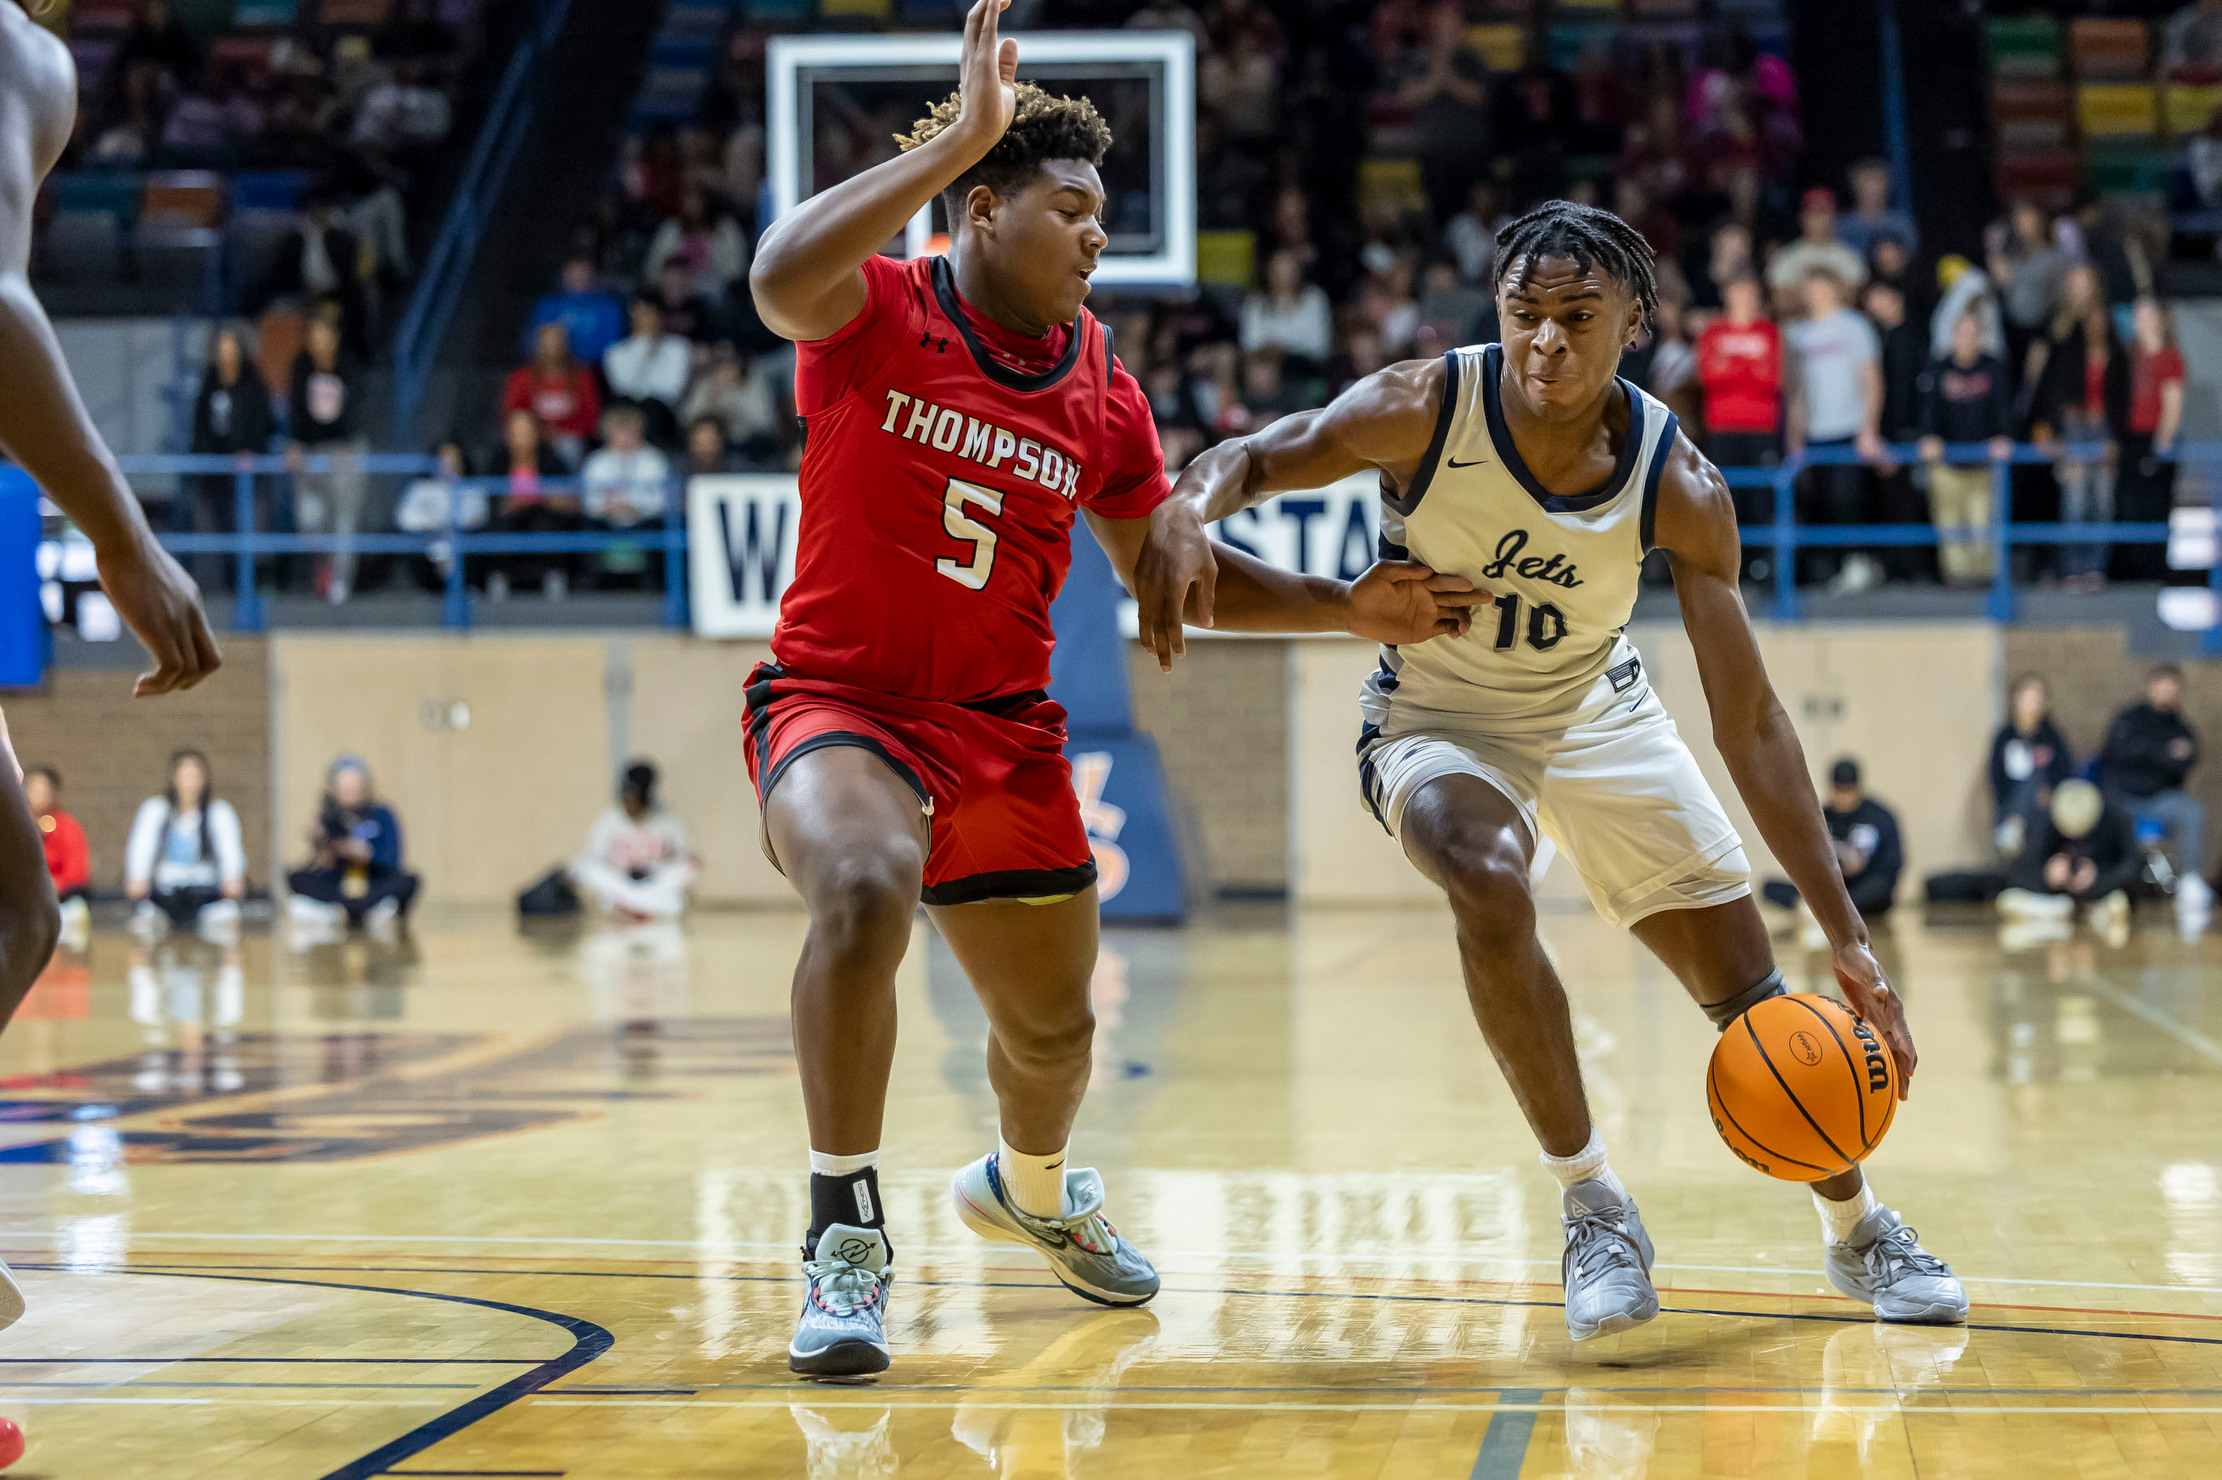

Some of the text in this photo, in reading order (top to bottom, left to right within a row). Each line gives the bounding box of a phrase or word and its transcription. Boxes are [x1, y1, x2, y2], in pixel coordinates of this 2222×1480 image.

[881, 388, 1082, 500] THOMPSON
[935, 475, 1007, 592] 5
[1482, 529, 1584, 588] Jets
[1492, 592, 1570, 652] 10
